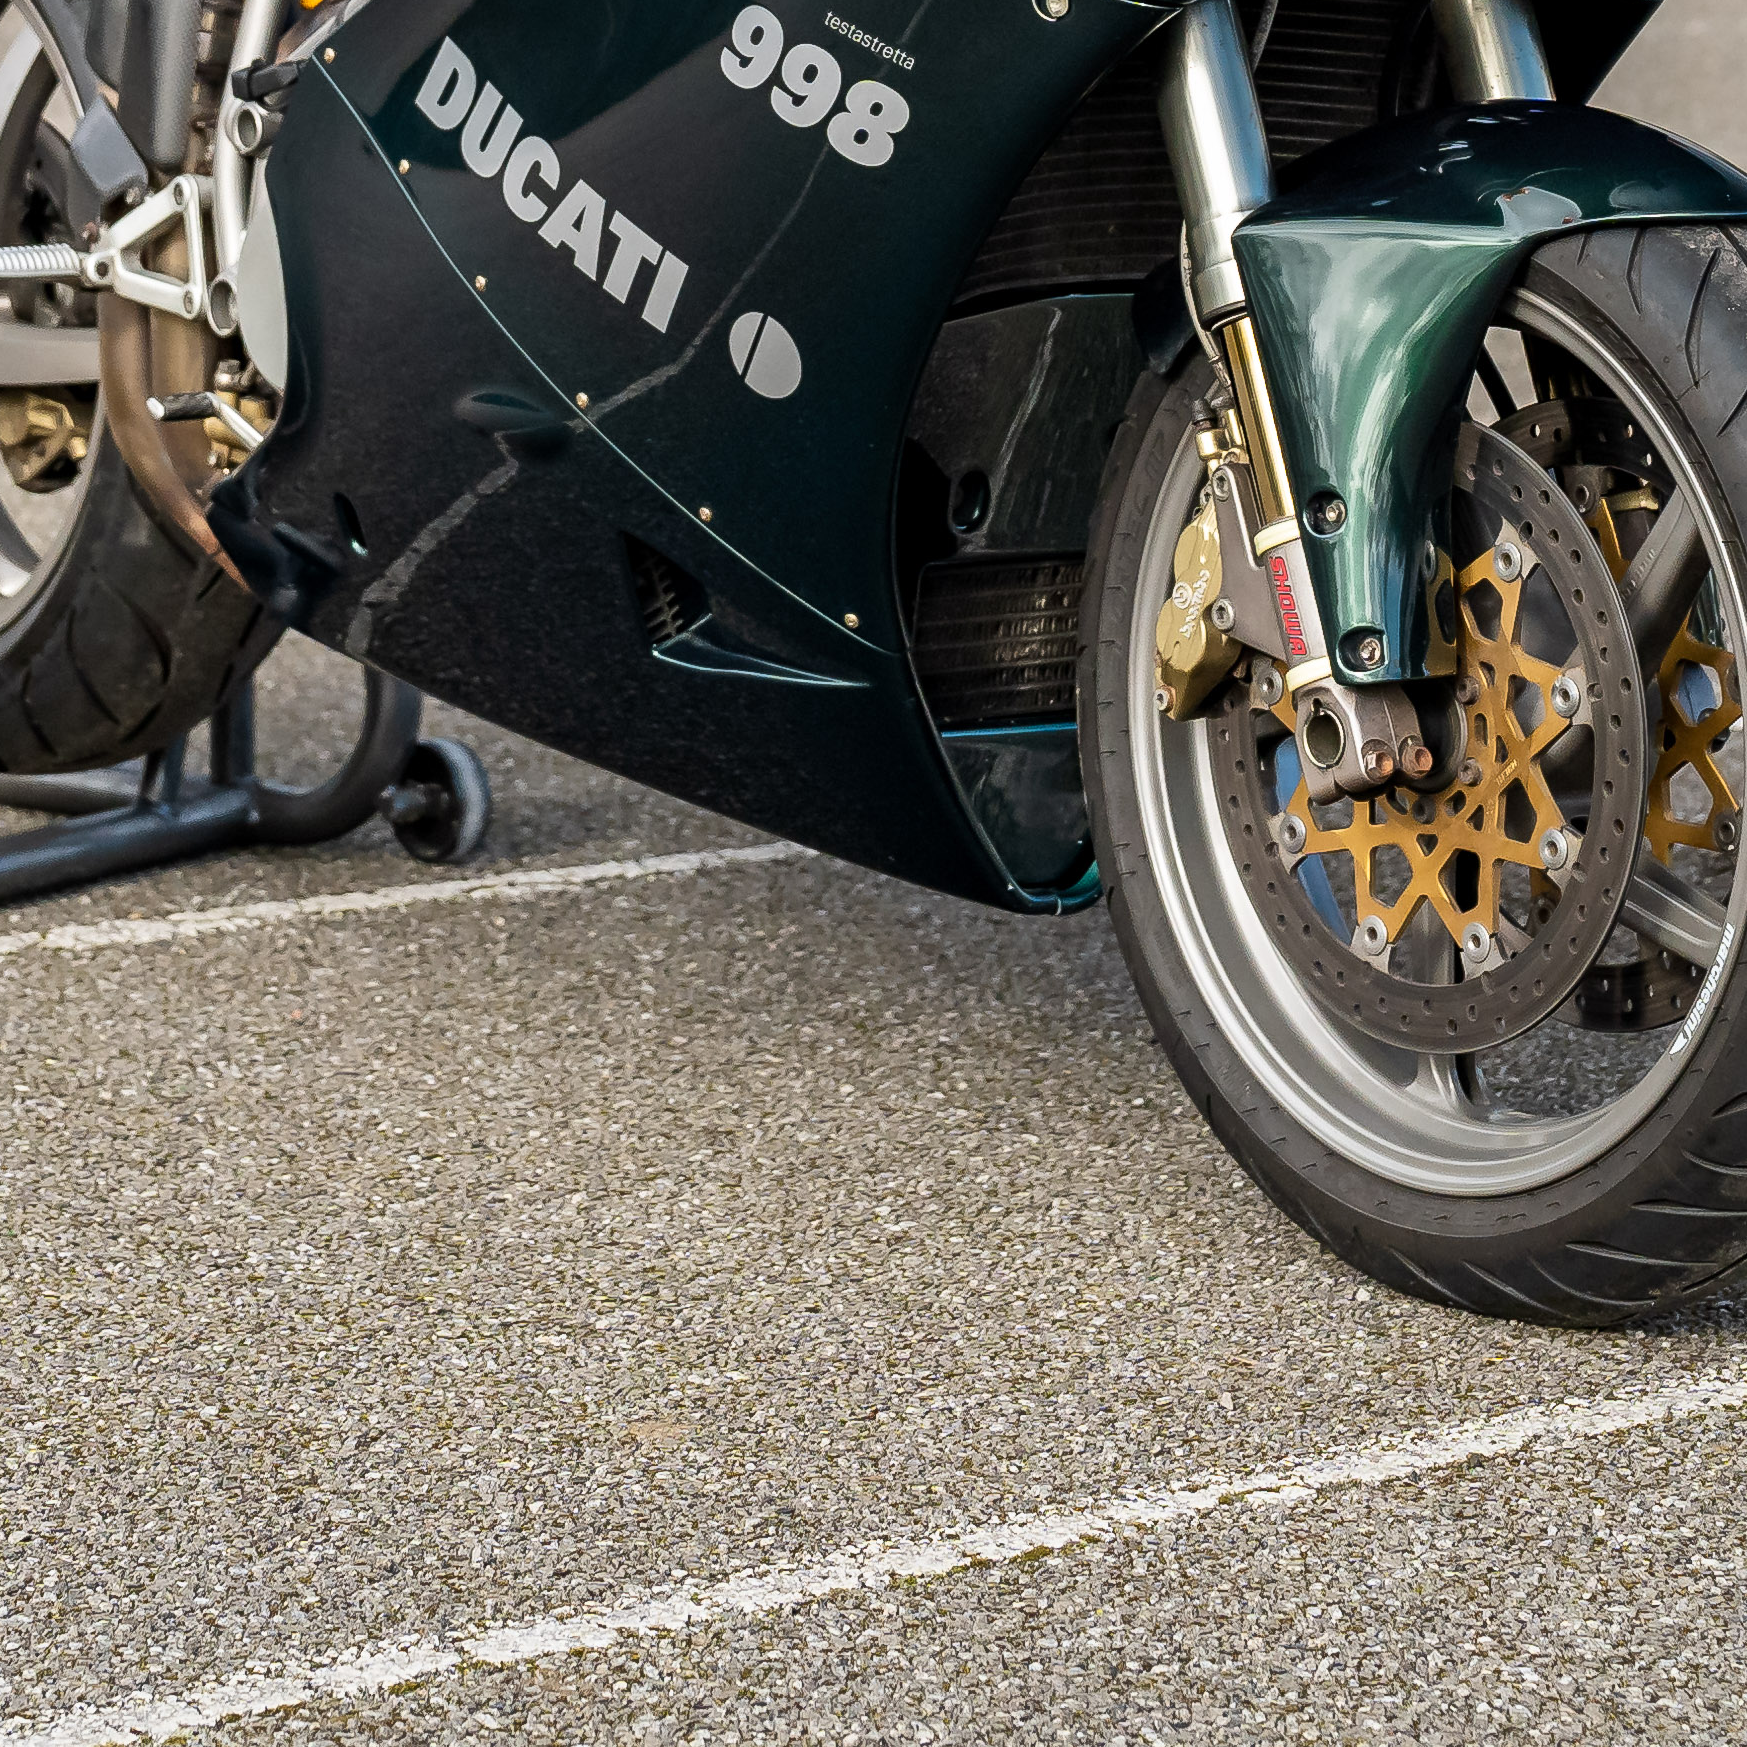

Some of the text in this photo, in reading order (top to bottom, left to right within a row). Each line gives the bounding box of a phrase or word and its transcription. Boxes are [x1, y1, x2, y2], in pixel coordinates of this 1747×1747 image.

[720, 5, 910, 167] 998
[823, 10, 916, 71] testastretta
[415, 35, 689, 334] DUCATI
[1179, 569, 1211, 639] brembo
[1269, 555, 1308, 656] SHOWA
